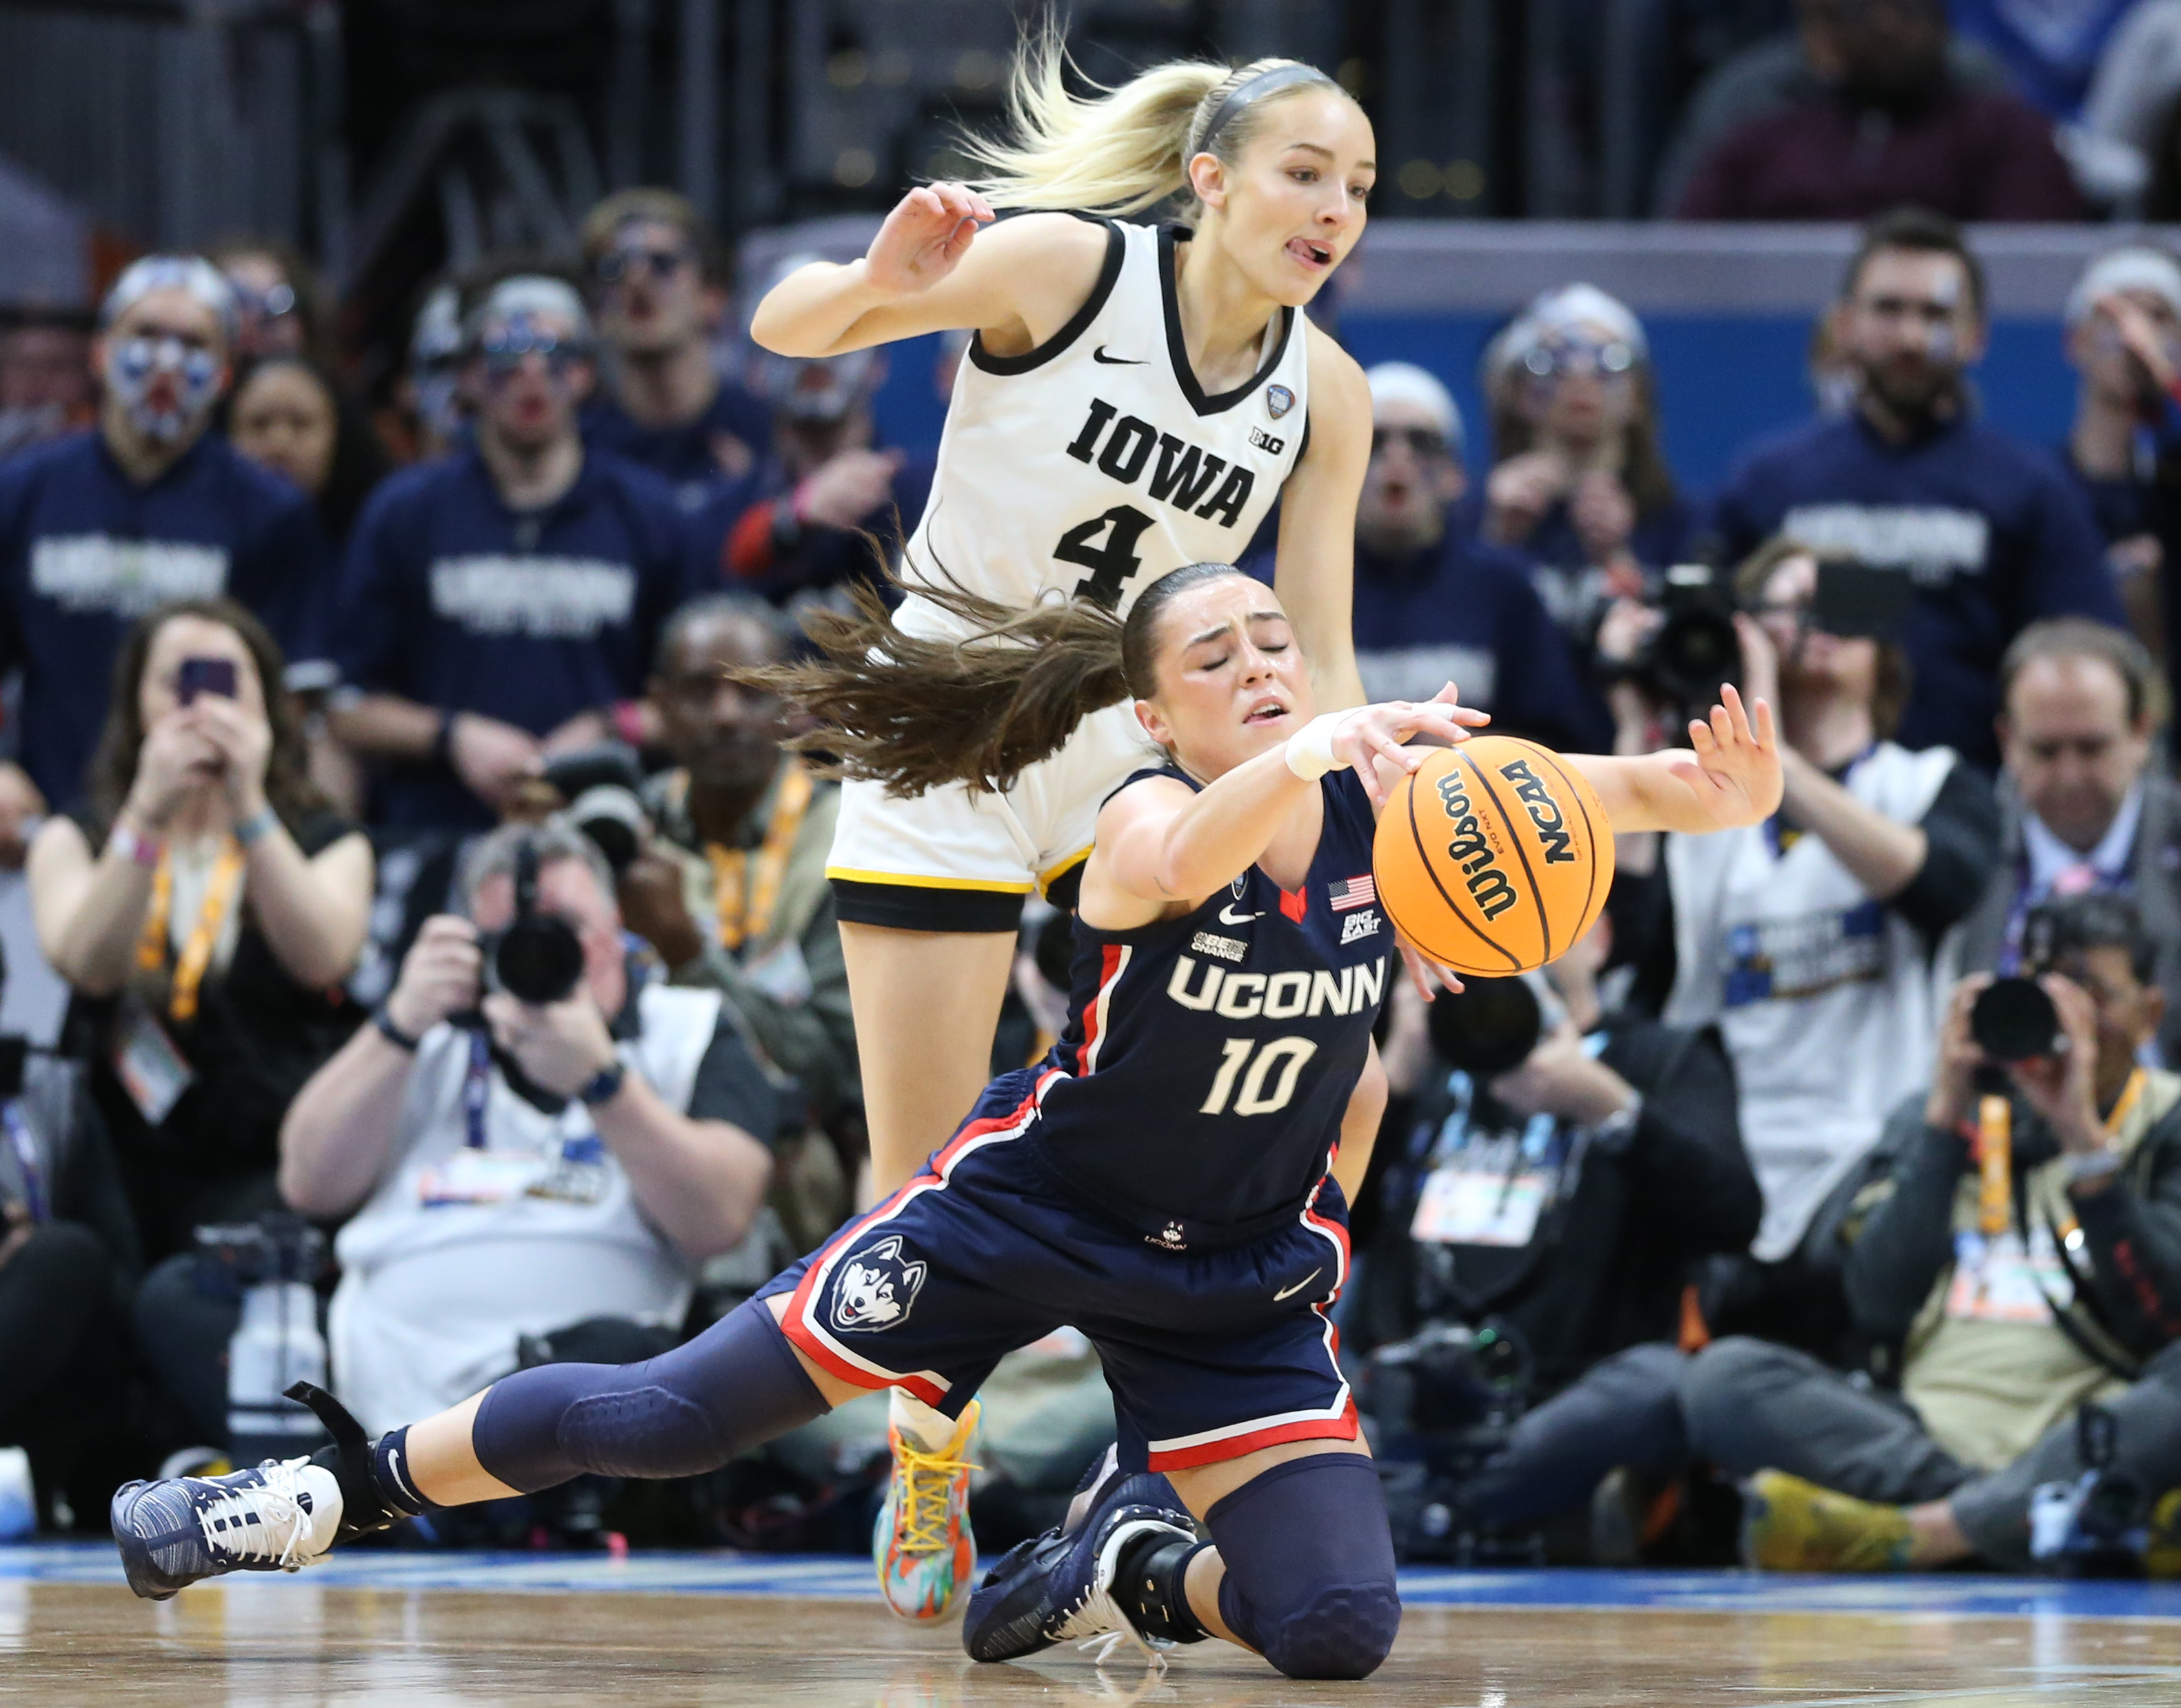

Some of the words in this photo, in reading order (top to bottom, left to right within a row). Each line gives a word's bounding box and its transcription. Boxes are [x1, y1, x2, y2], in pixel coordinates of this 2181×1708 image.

[1066, 397, 1256, 529] IOWA
[1052, 504, 1156, 610] 4
[1436, 768, 1518, 923] Wilson
[1478, 809, 1492, 830] NXT
[1499, 759, 1576, 864] NCAA
[1191, 942, 1245, 963] CHANGE
[1341, 916, 1382, 938] EAST
[1344, 909, 1375, 927] BIG
[1166, 954, 1386, 1019] UCONN
[1198, 1036, 1318, 1117] 10
